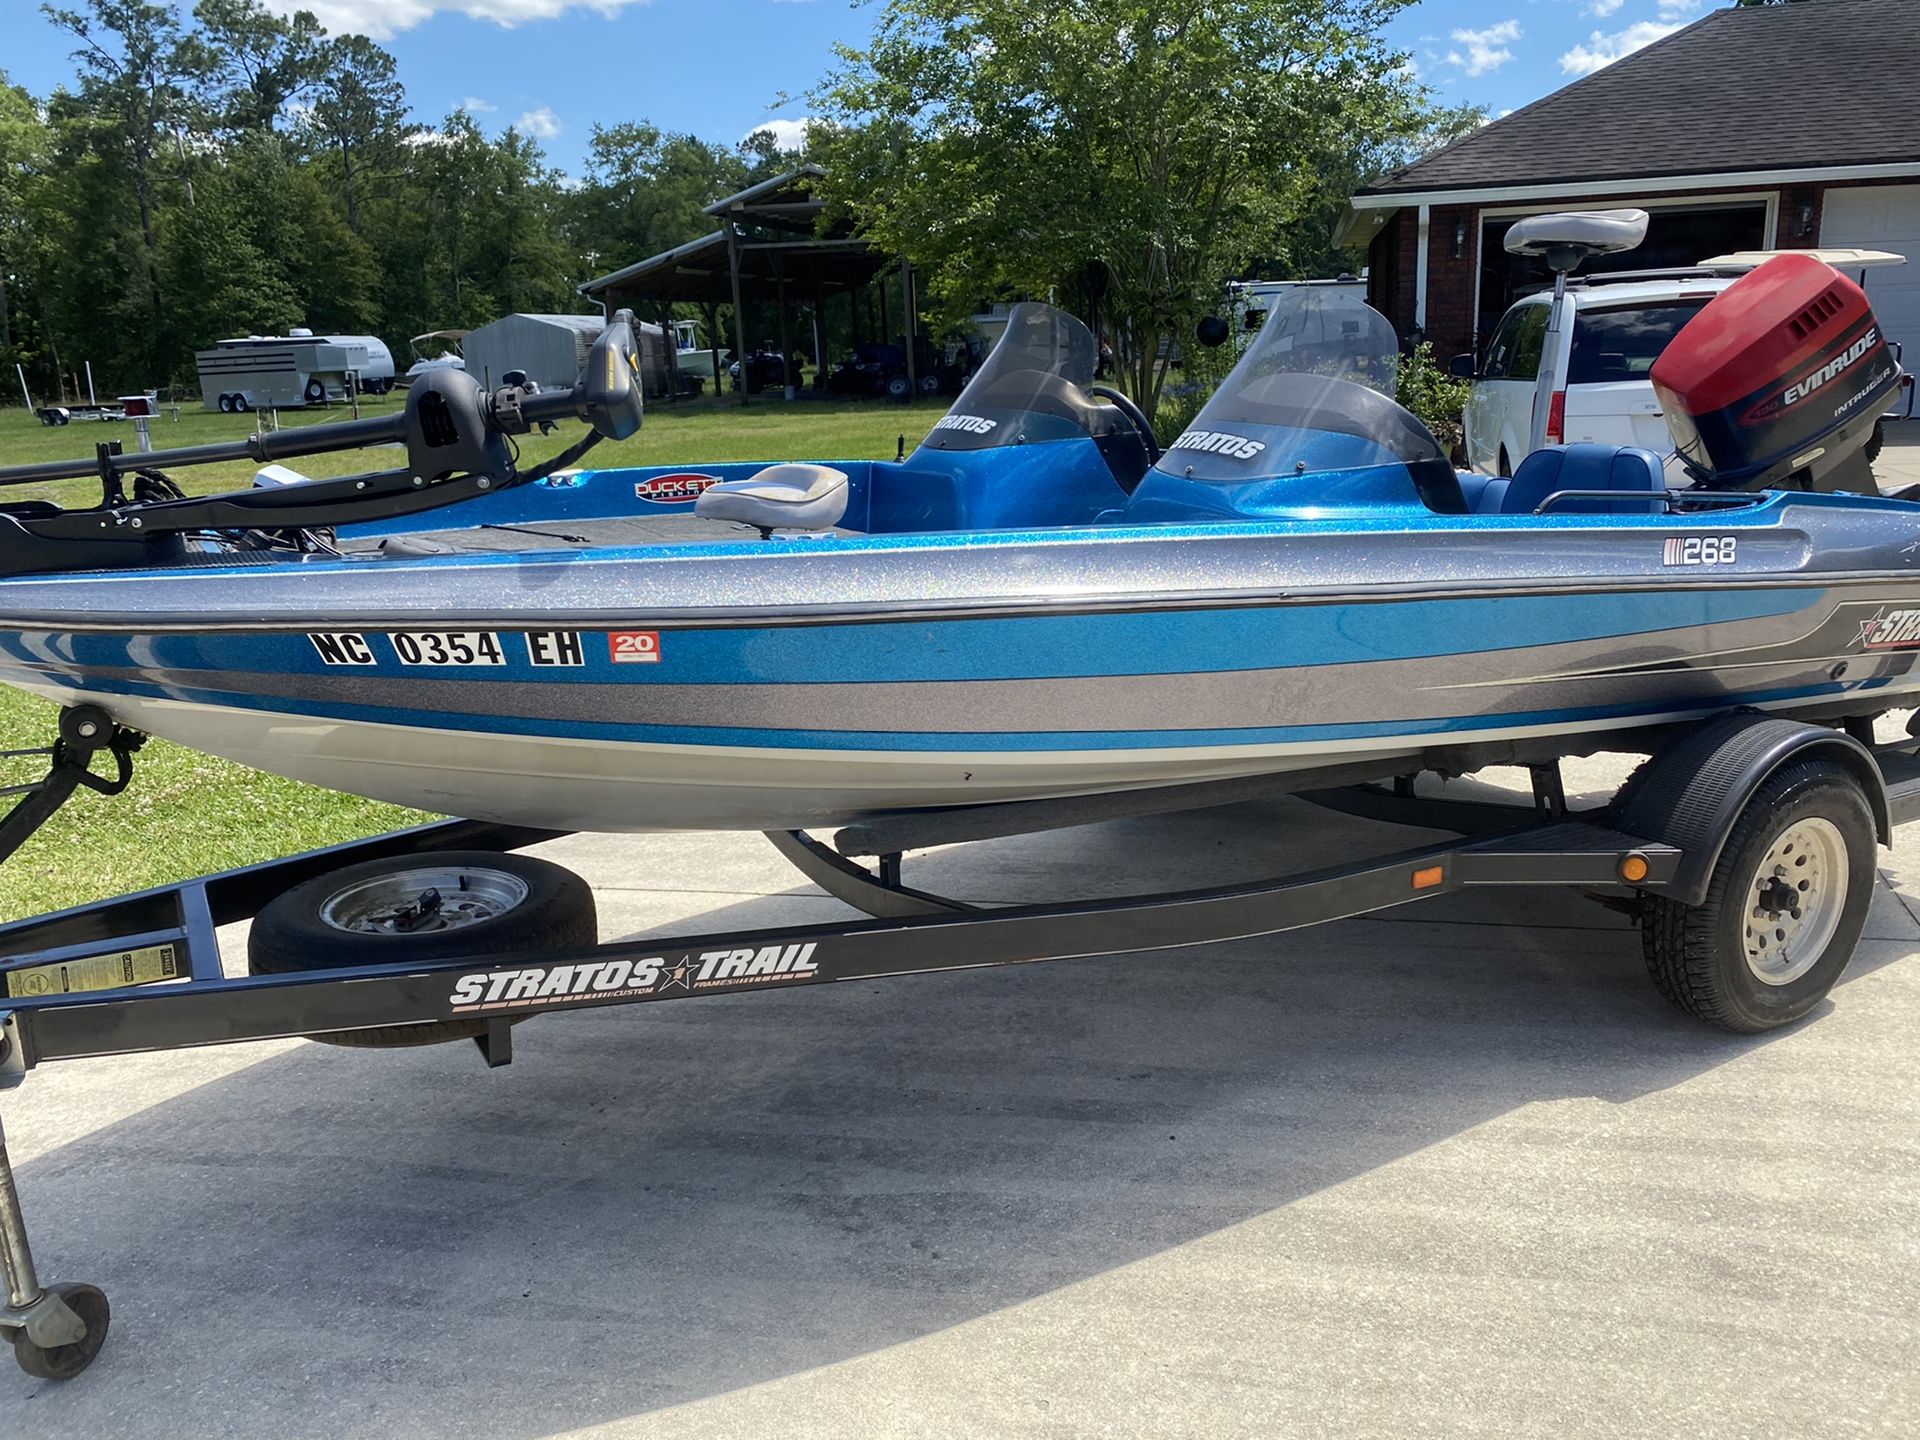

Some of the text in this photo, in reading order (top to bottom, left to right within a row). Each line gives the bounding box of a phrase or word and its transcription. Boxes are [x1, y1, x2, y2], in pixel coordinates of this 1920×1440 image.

[1784, 328, 1877, 405] EVINRUDE
[1834, 367, 1891, 417] INTRUDER
[1683, 537, 1737, 565] 268
[310, 632, 583, 665] NC 0354 EH
[615, 635, 655, 651] 20
[450, 957, 665, 1005] STRATOS
[695, 942, 819, 982] TRAIL
[693, 978, 733, 989] FRAMES
[613, 986, 655, 998] CUSTOM
